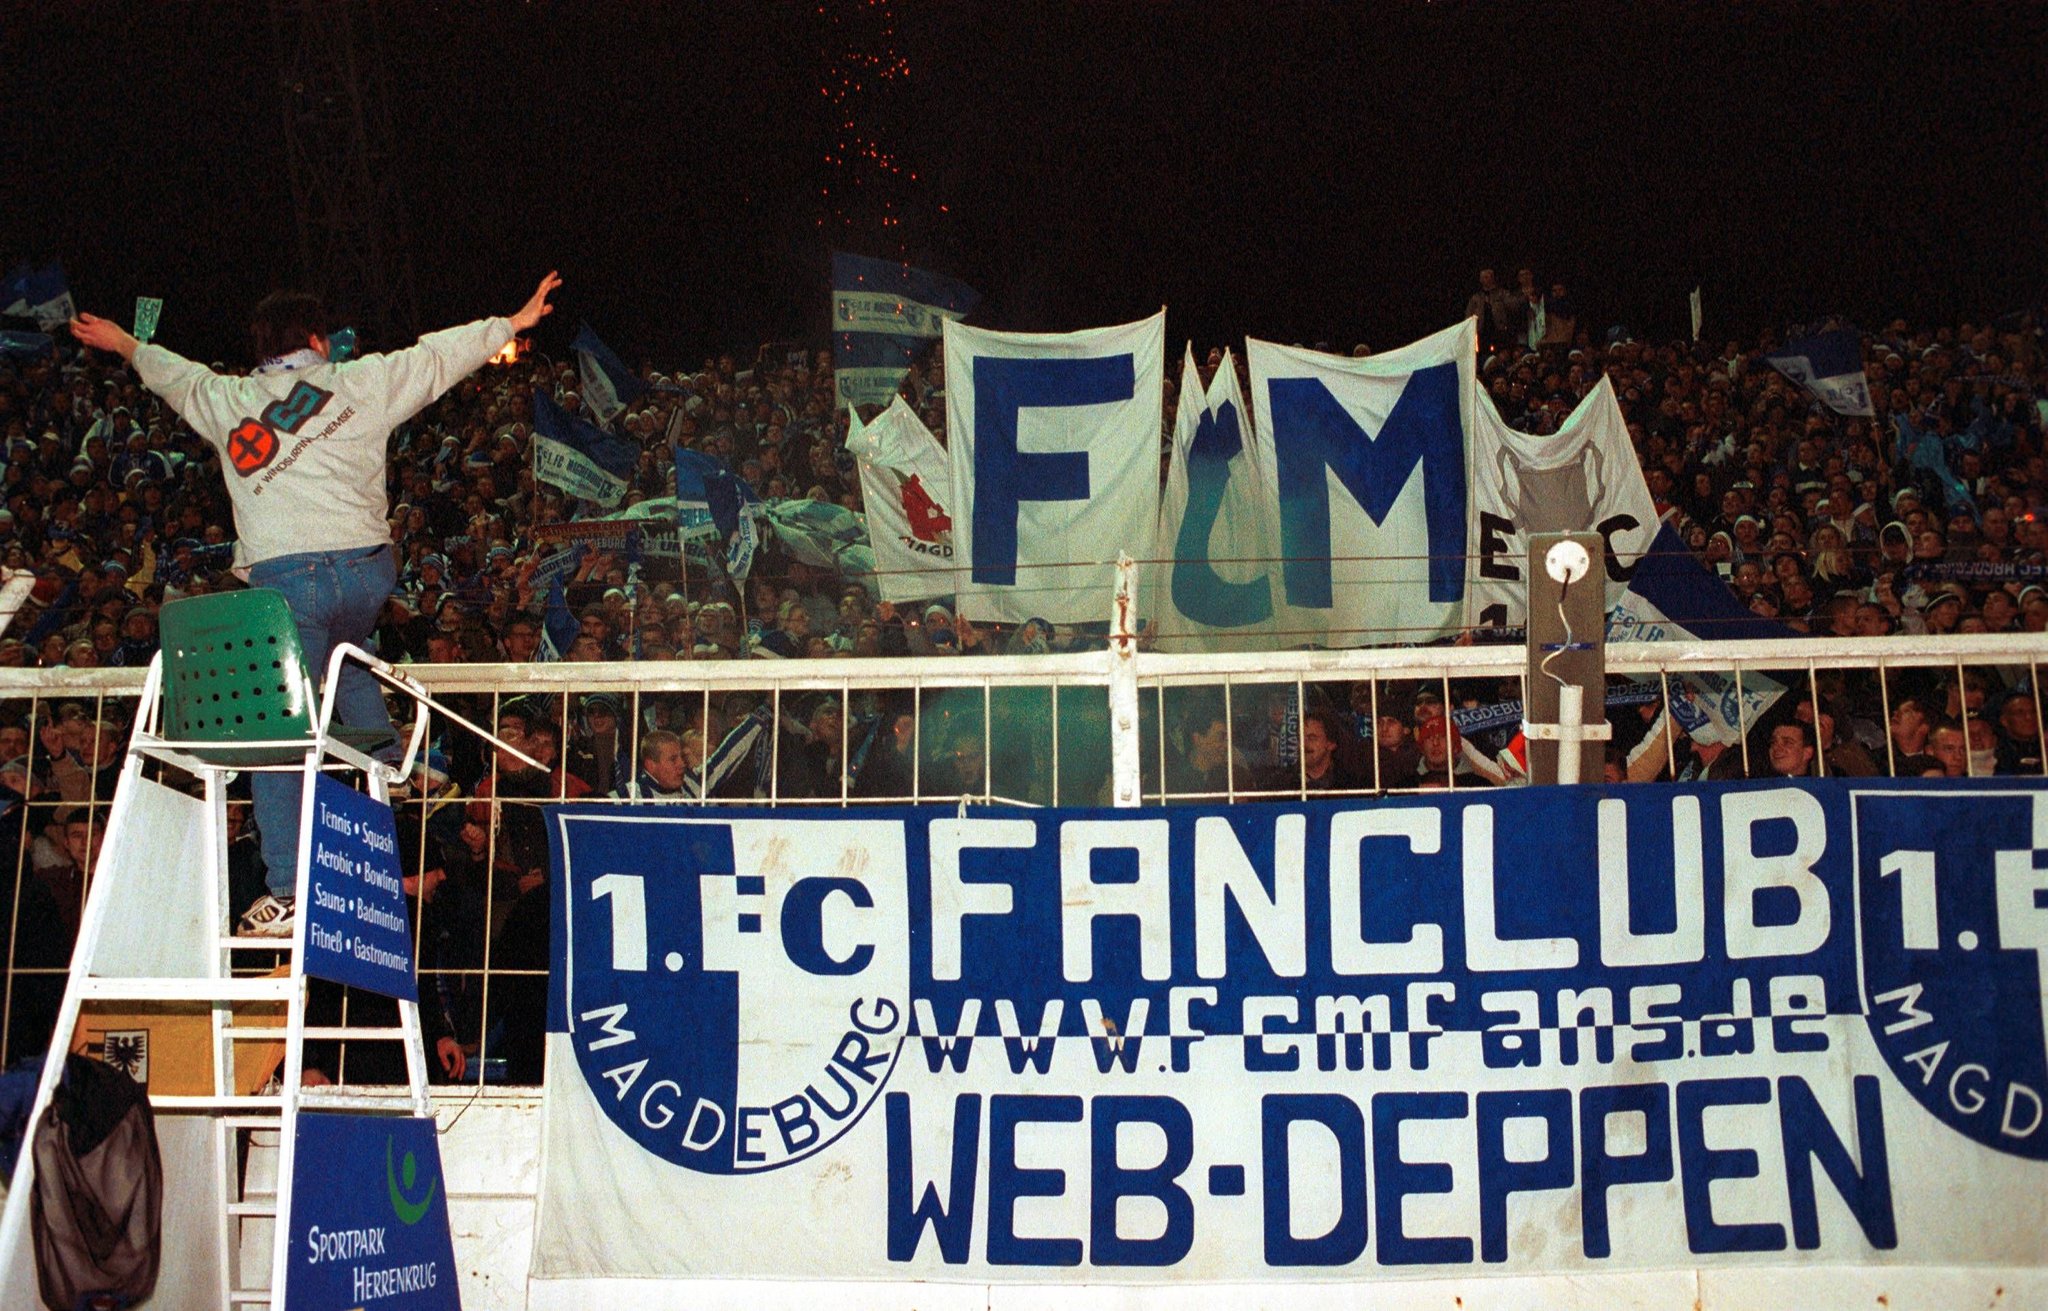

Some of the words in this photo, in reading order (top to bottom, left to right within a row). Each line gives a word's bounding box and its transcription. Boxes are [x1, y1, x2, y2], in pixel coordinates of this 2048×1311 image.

[261, 436, 314, 484] WINDSURFIN
[971, 352, 1135, 586] F
[1267, 360, 1468, 609] M
[320, 802, 352, 836] Tennis
[361, 821, 394, 855] Squash
[316, 842, 354, 877] Aerobic
[364, 861, 399, 900] Bowling
[929, 787, 1832, 982] FANCLUB
[314, 882, 346, 914] Sauna
[357, 897, 404, 934] Badminton
[354, 936, 408, 973] Gastronomie
[581, 996, 900, 1162] MAGDEBURG
[1873, 982, 2043, 1139] MAGD
[885, 1074, 1899, 1267] WEB-DEPPEN
[308, 1225, 386, 1264] SPORTPARK
[353, 1261, 437, 1303] HERRENKRUG
